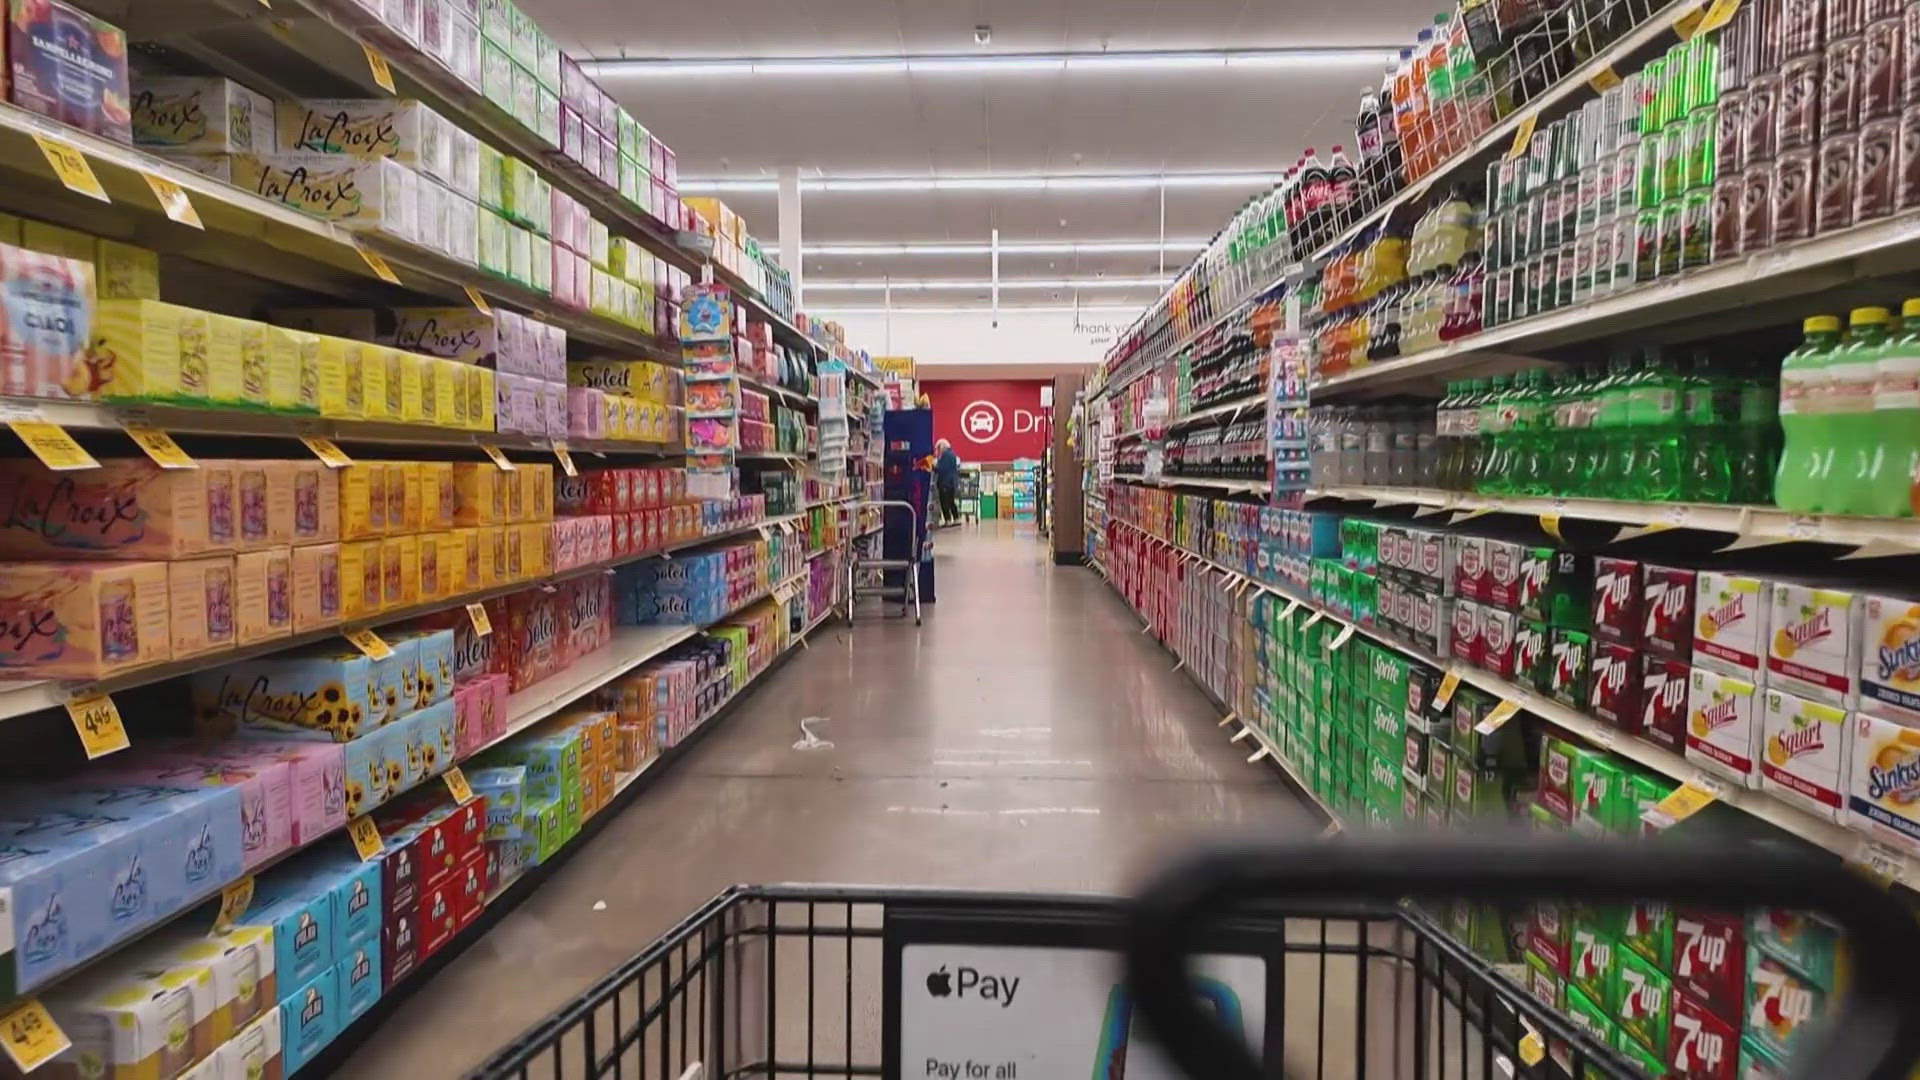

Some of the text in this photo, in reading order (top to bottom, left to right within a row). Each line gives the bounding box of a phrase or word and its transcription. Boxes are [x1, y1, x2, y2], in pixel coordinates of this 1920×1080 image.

[582, 365, 631, 388] Soleil
[1558, 553, 1575, 567] 12
[1374, 651, 1400, 685] Sprite
[1373, 704, 1399, 738] Sprite
[1778, 720, 1822, 757] Squirt
[1371, 756, 1397, 791] Sprite
[957, 966, 1020, 1008] Pay
[926, 1057, 1017, 1080] Pay for all
